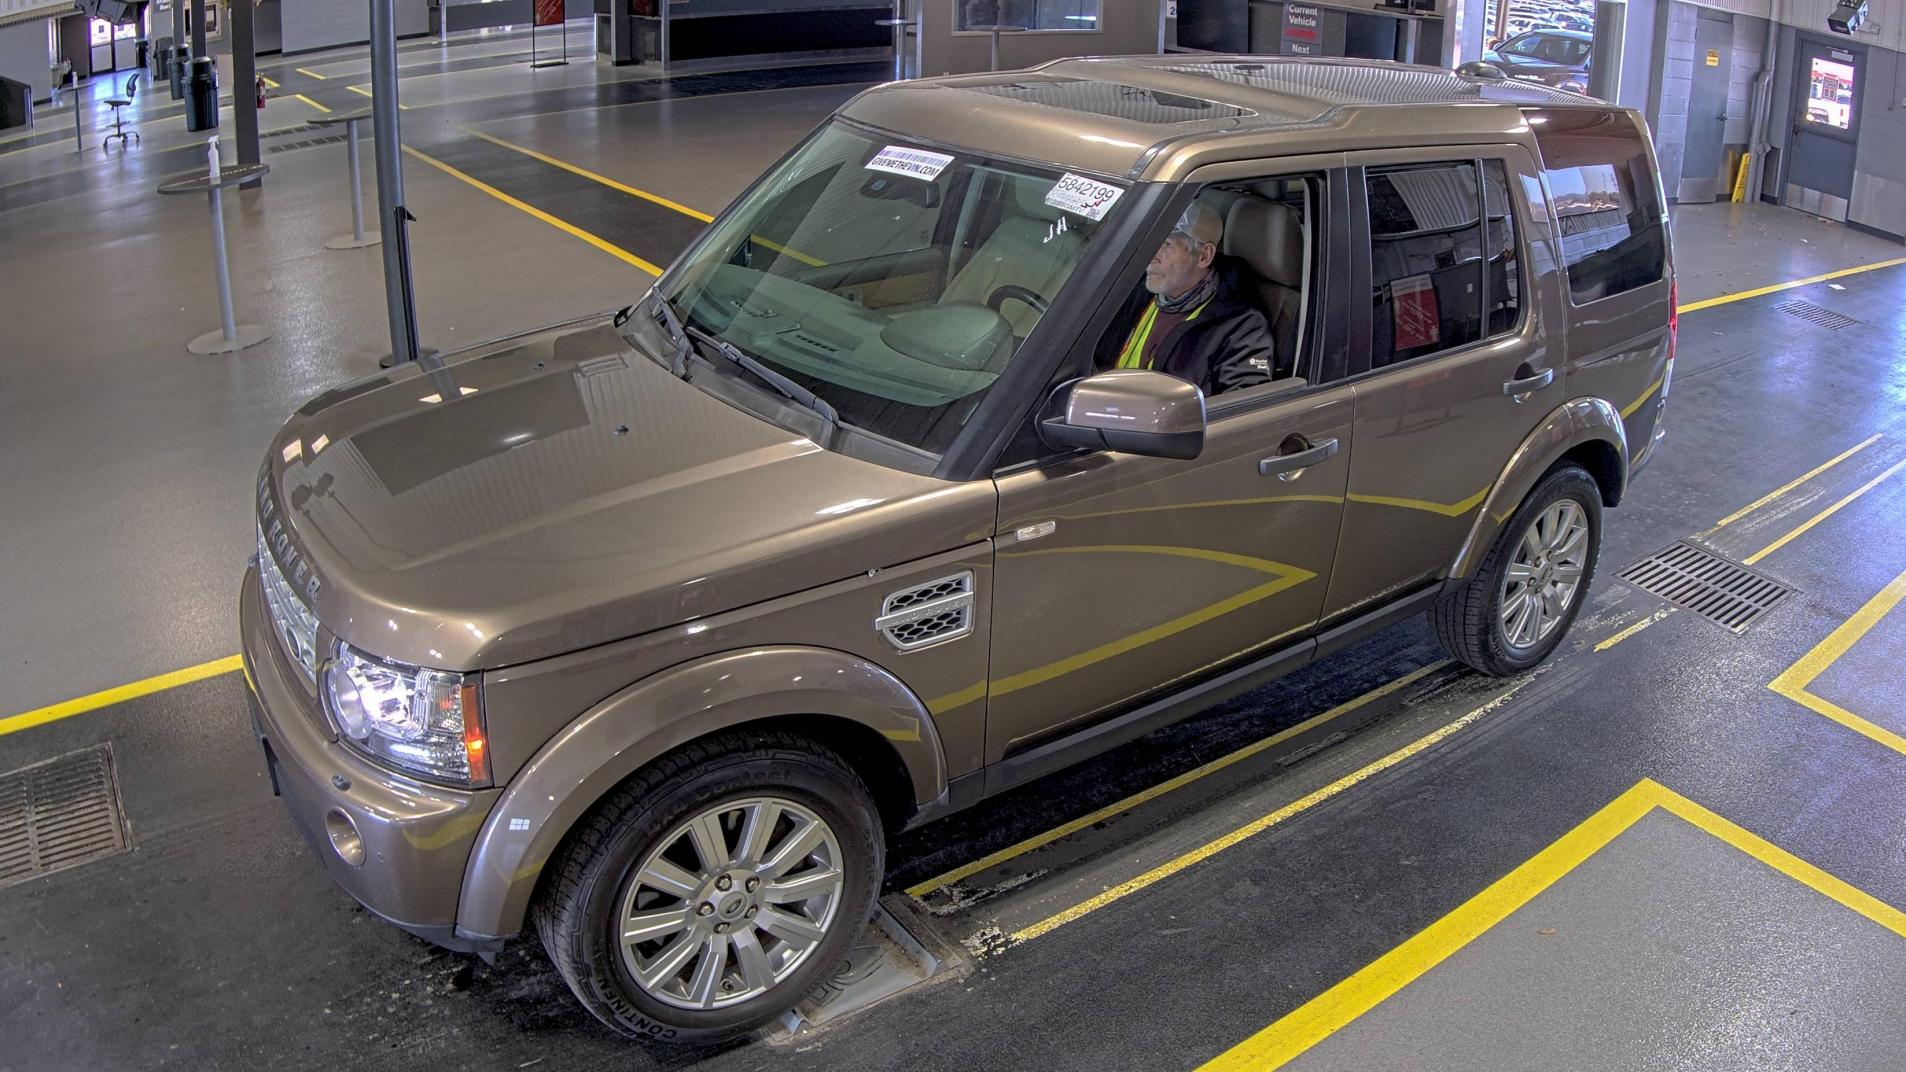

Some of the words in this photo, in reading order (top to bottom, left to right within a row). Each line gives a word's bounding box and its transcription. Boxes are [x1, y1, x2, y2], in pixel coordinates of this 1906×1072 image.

[1288, 4, 1318, 16] Current
[1288, 15, 1317, 27] Vehicle
[1291, 43, 1310, 55] Next
[871, 157, 940, 177] GIVEMETHEVIN.COM
[1058, 176, 1115, 202] 5842199
[268, 519, 321, 603] ROVER
